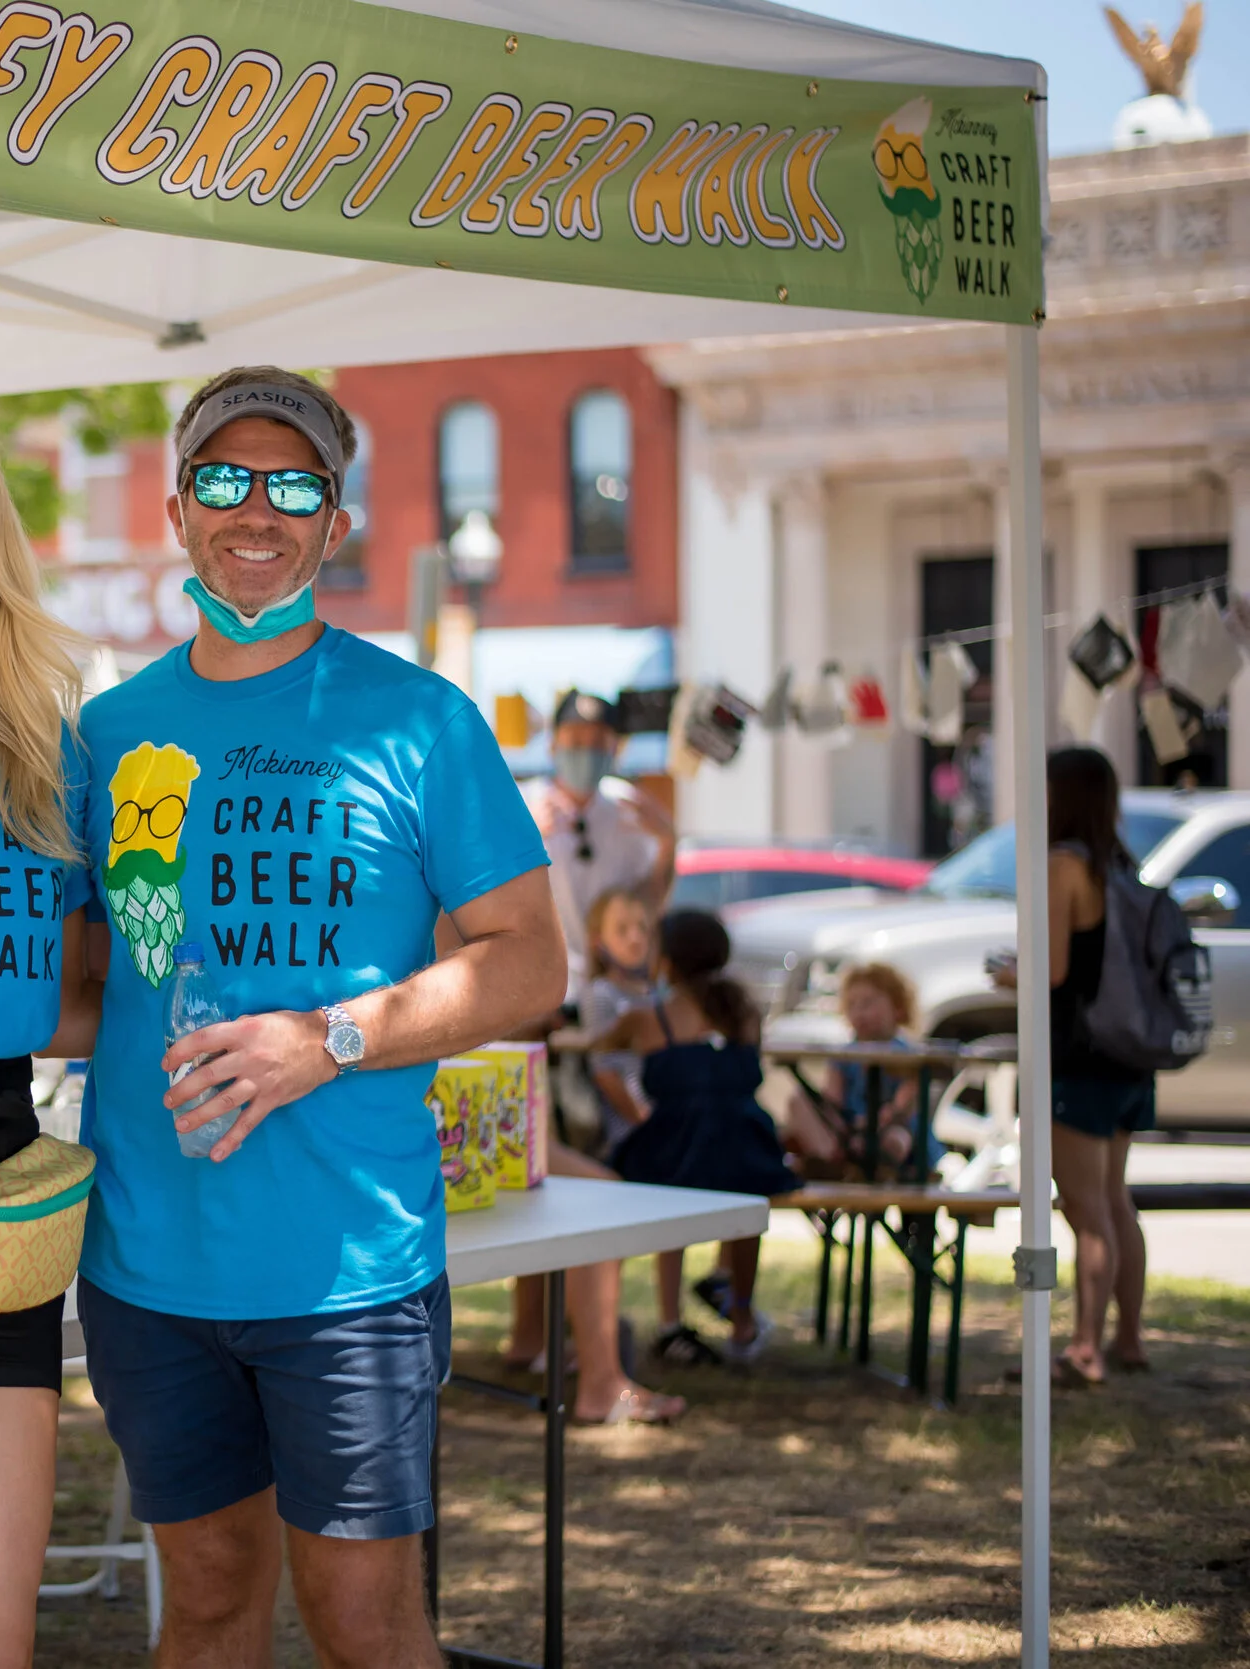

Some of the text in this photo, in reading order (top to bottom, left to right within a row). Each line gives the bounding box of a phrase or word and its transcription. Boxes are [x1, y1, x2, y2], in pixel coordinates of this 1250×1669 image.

[96, 35, 452, 219] CRAFT
[409, 92, 655, 241] BEER
[629, 119, 847, 251] WALK
[939, 151, 1011, 189] CRAFT
[952, 196, 1016, 248] BEER
[954, 255, 1011, 298] WALK
[221, 391, 307, 415] SEASIDE
[217, 744, 346, 789] Mckinney
[213, 796, 358, 839] CRAFT
[211, 851, 357, 907] BEER
[210, 922, 340, 967] WALK
